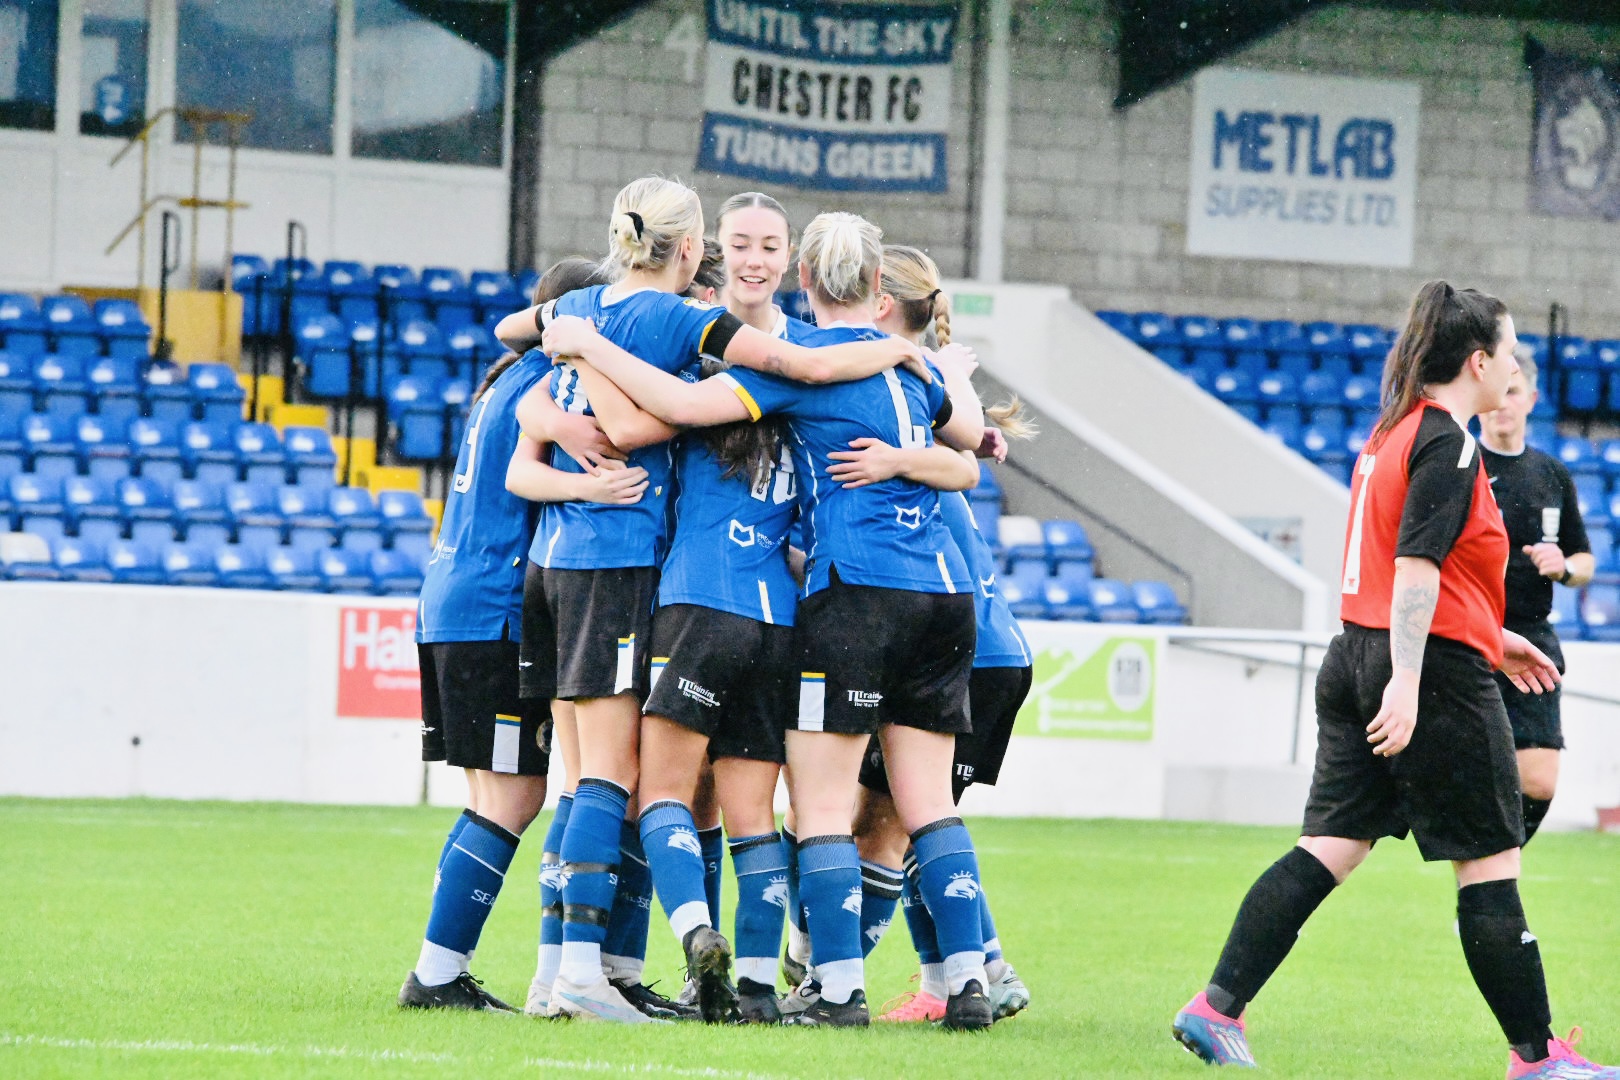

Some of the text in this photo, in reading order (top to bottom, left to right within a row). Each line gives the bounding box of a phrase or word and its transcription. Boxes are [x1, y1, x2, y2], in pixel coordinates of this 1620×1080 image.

[715, 0, 949, 54] UNTIL THE SKY
[732, 57, 922, 123] CHESTER FC
[712, 124, 936, 179] TURNS GREEN
[1213, 109, 1396, 180] METLAB
[1205, 184, 1396, 227] SUPPLIES LTD
[1341, 454, 1376, 595] 7
[343, 609, 420, 671] Hai
